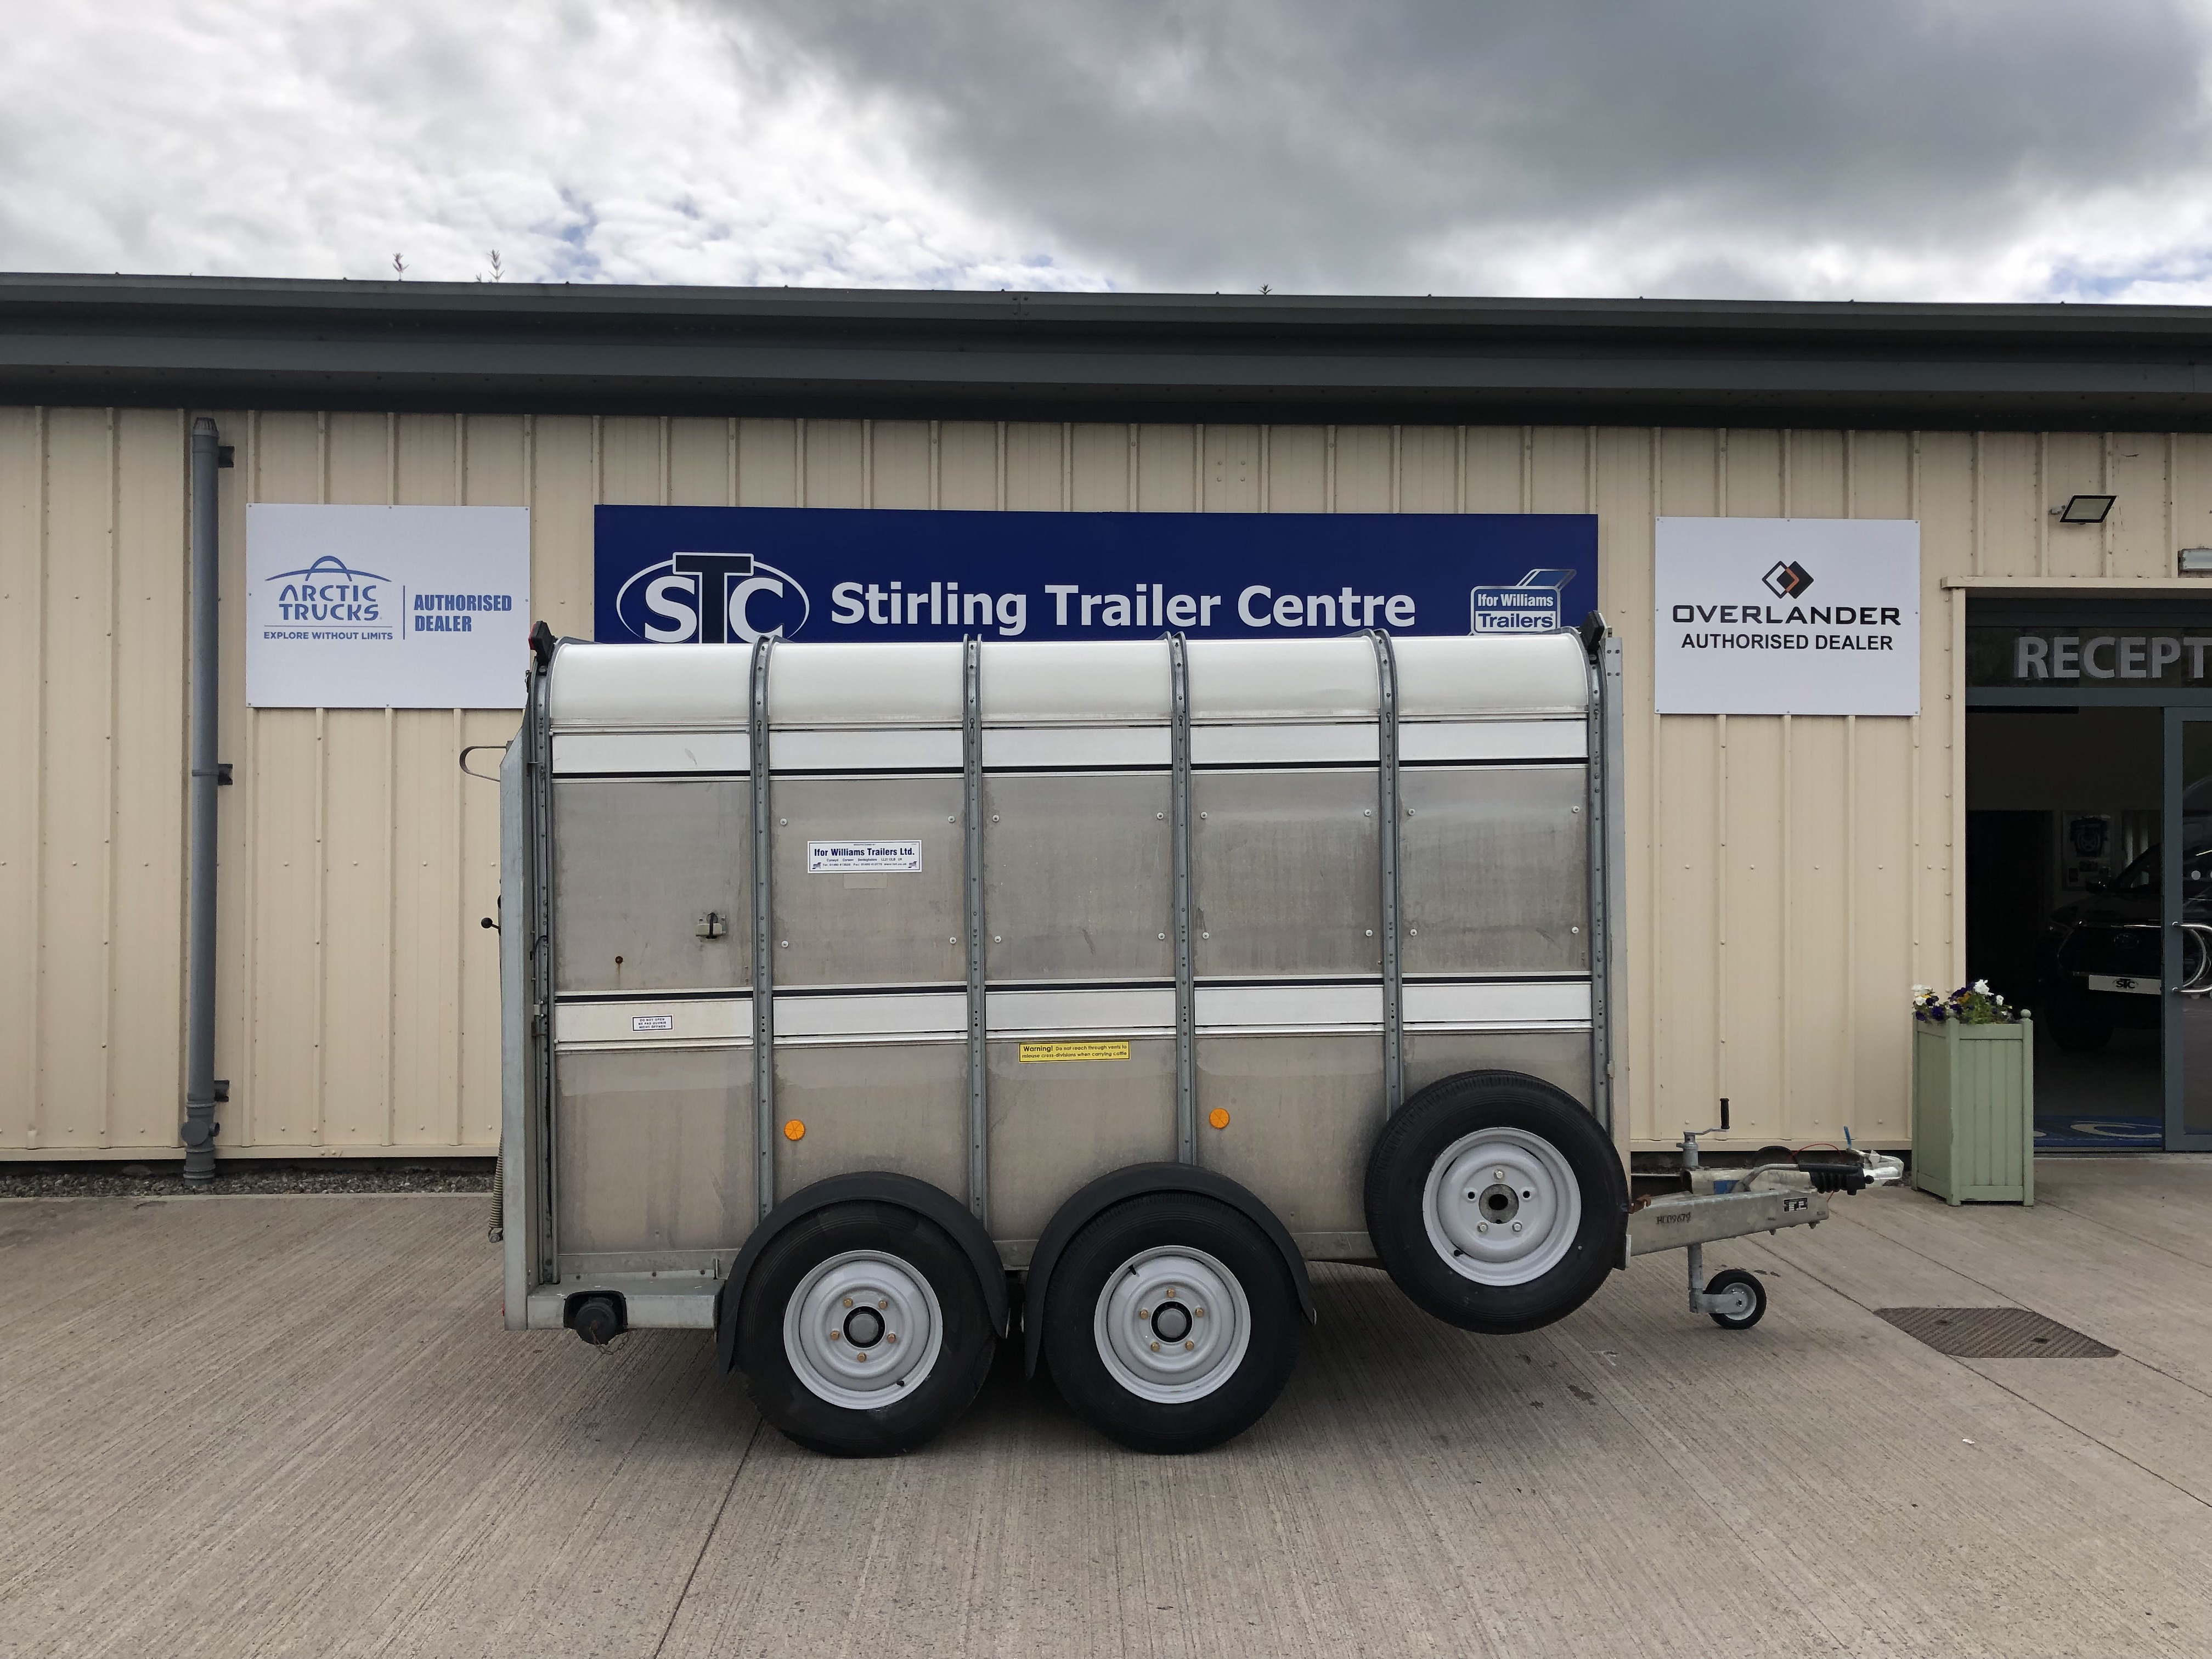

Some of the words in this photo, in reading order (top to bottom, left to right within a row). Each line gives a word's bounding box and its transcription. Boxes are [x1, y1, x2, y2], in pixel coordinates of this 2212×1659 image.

[279, 585, 377, 602] ARCTIC
[645, 552, 783, 644] STC
[1477, 594, 1499, 606] Ifor
[1500, 594, 1554, 606] Williams
[414, 595, 512, 611] AUTHORISED
[831, 582, 1026, 636] Stirling
[1045, 584, 1221, 627] Trailer
[1237, 585, 1415, 627] Centre
[279, 603, 379, 621] TRUCKS
[1478, 613, 1554, 628] Trailers
[1673, 605, 1901, 625] OVERLANDER
[415, 616, 472, 632] DEALER
[264, 631, 309, 640] EXPLORE
[361, 632, 393, 640] LIMITS
[1681, 633, 1808, 650] AUTHORISED
[1815, 635, 1893, 651] DEALER
[2015, 636, 2212, 679] RECEPT
